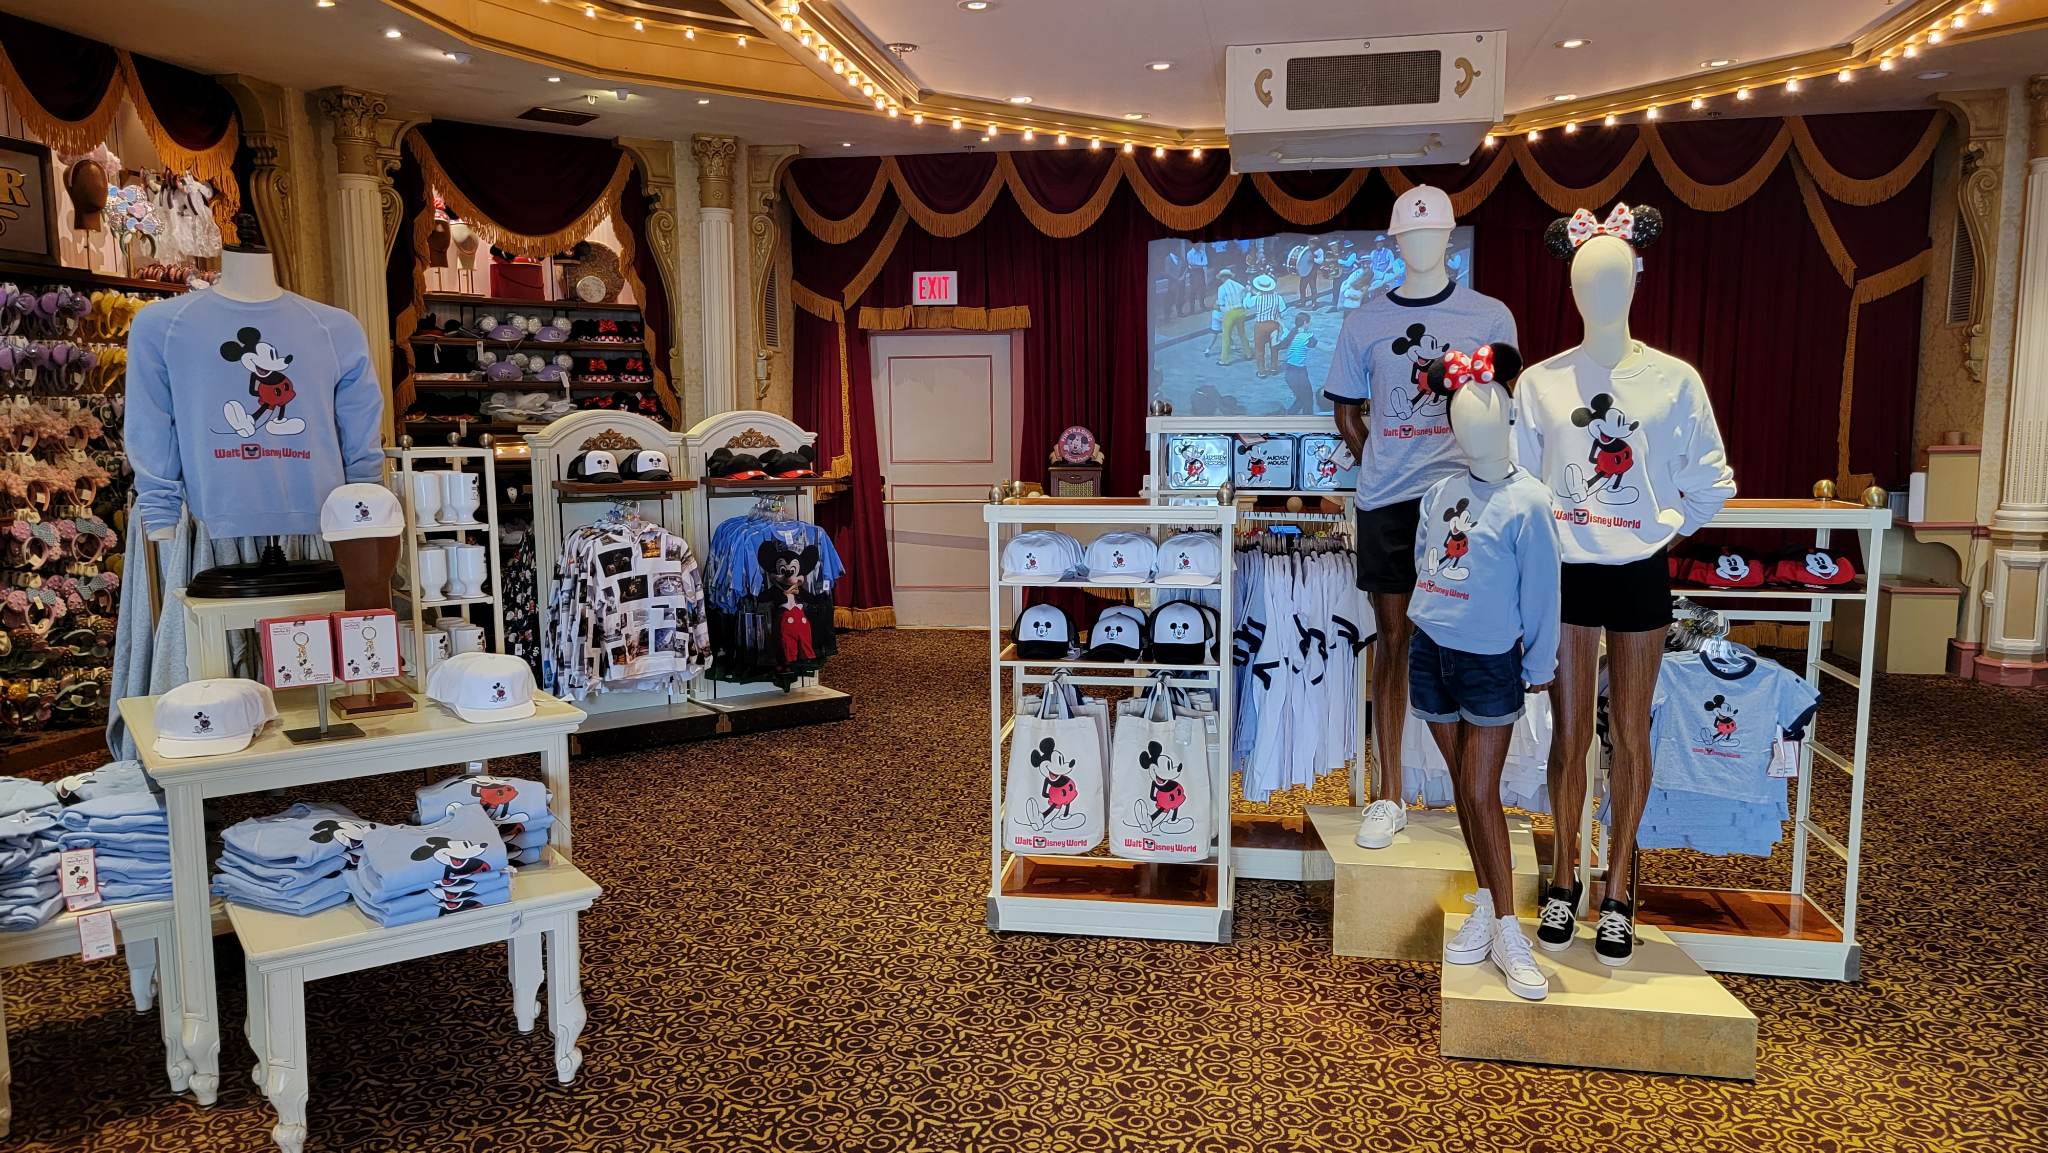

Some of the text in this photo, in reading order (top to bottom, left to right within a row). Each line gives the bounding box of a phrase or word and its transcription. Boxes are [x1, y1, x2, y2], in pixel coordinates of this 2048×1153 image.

[918, 276, 952, 300] EXIT
[214, 448, 241, 459] Walt
[282, 447, 311, 460] World
[1613, 516, 1641, 529] World
[1015, 836, 1033, 846] Walt
[1066, 839, 1088, 847] World
[1124, 838, 1143, 848] Walt
[1175, 844, 1197, 853] World
